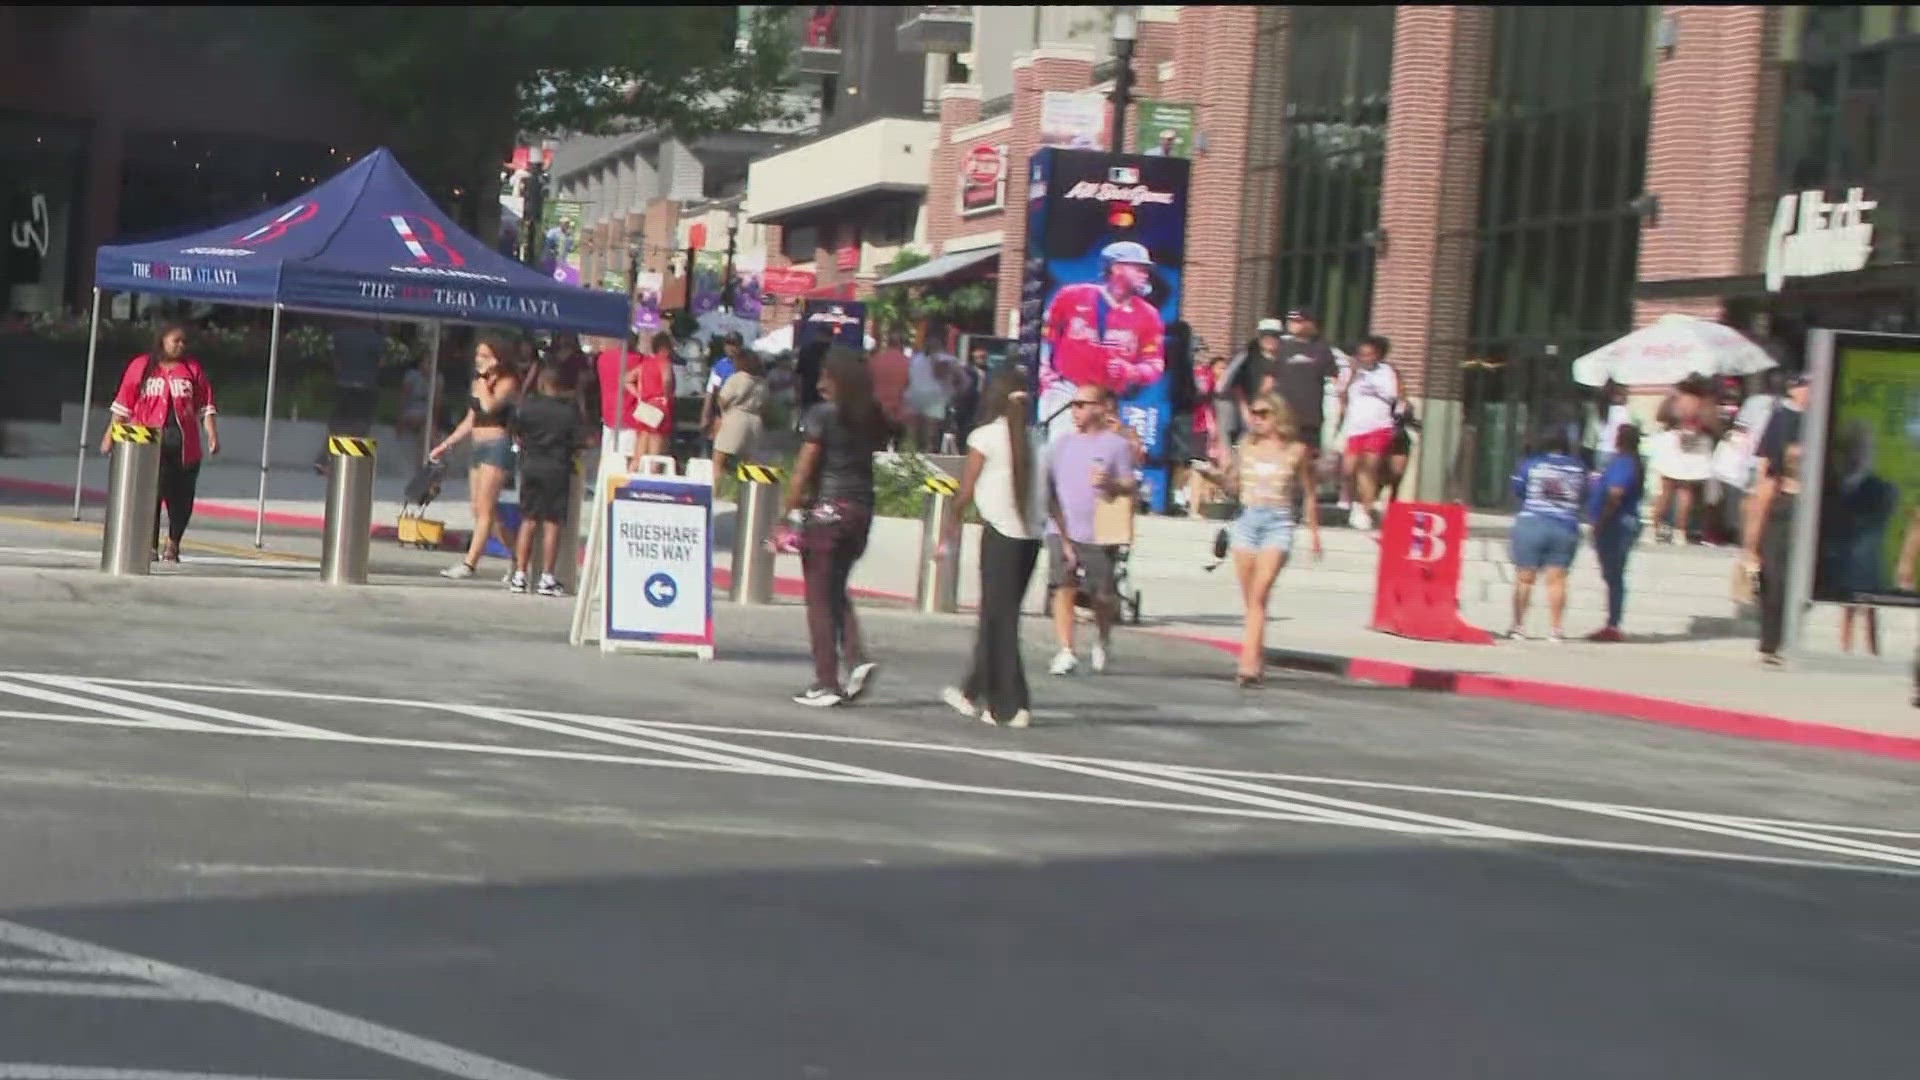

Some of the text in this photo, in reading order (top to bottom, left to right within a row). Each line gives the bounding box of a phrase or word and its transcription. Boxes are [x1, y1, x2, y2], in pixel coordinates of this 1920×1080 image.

[132, 262, 151, 279] THE
[152, 262, 192, 282] TERY
[359, 280, 560, 318] THE TERY ATLANTA
[620, 522, 699, 545] RIDESHARE
[1402, 510, 1447, 562] B
[627, 541, 693, 563] THIS WAY
